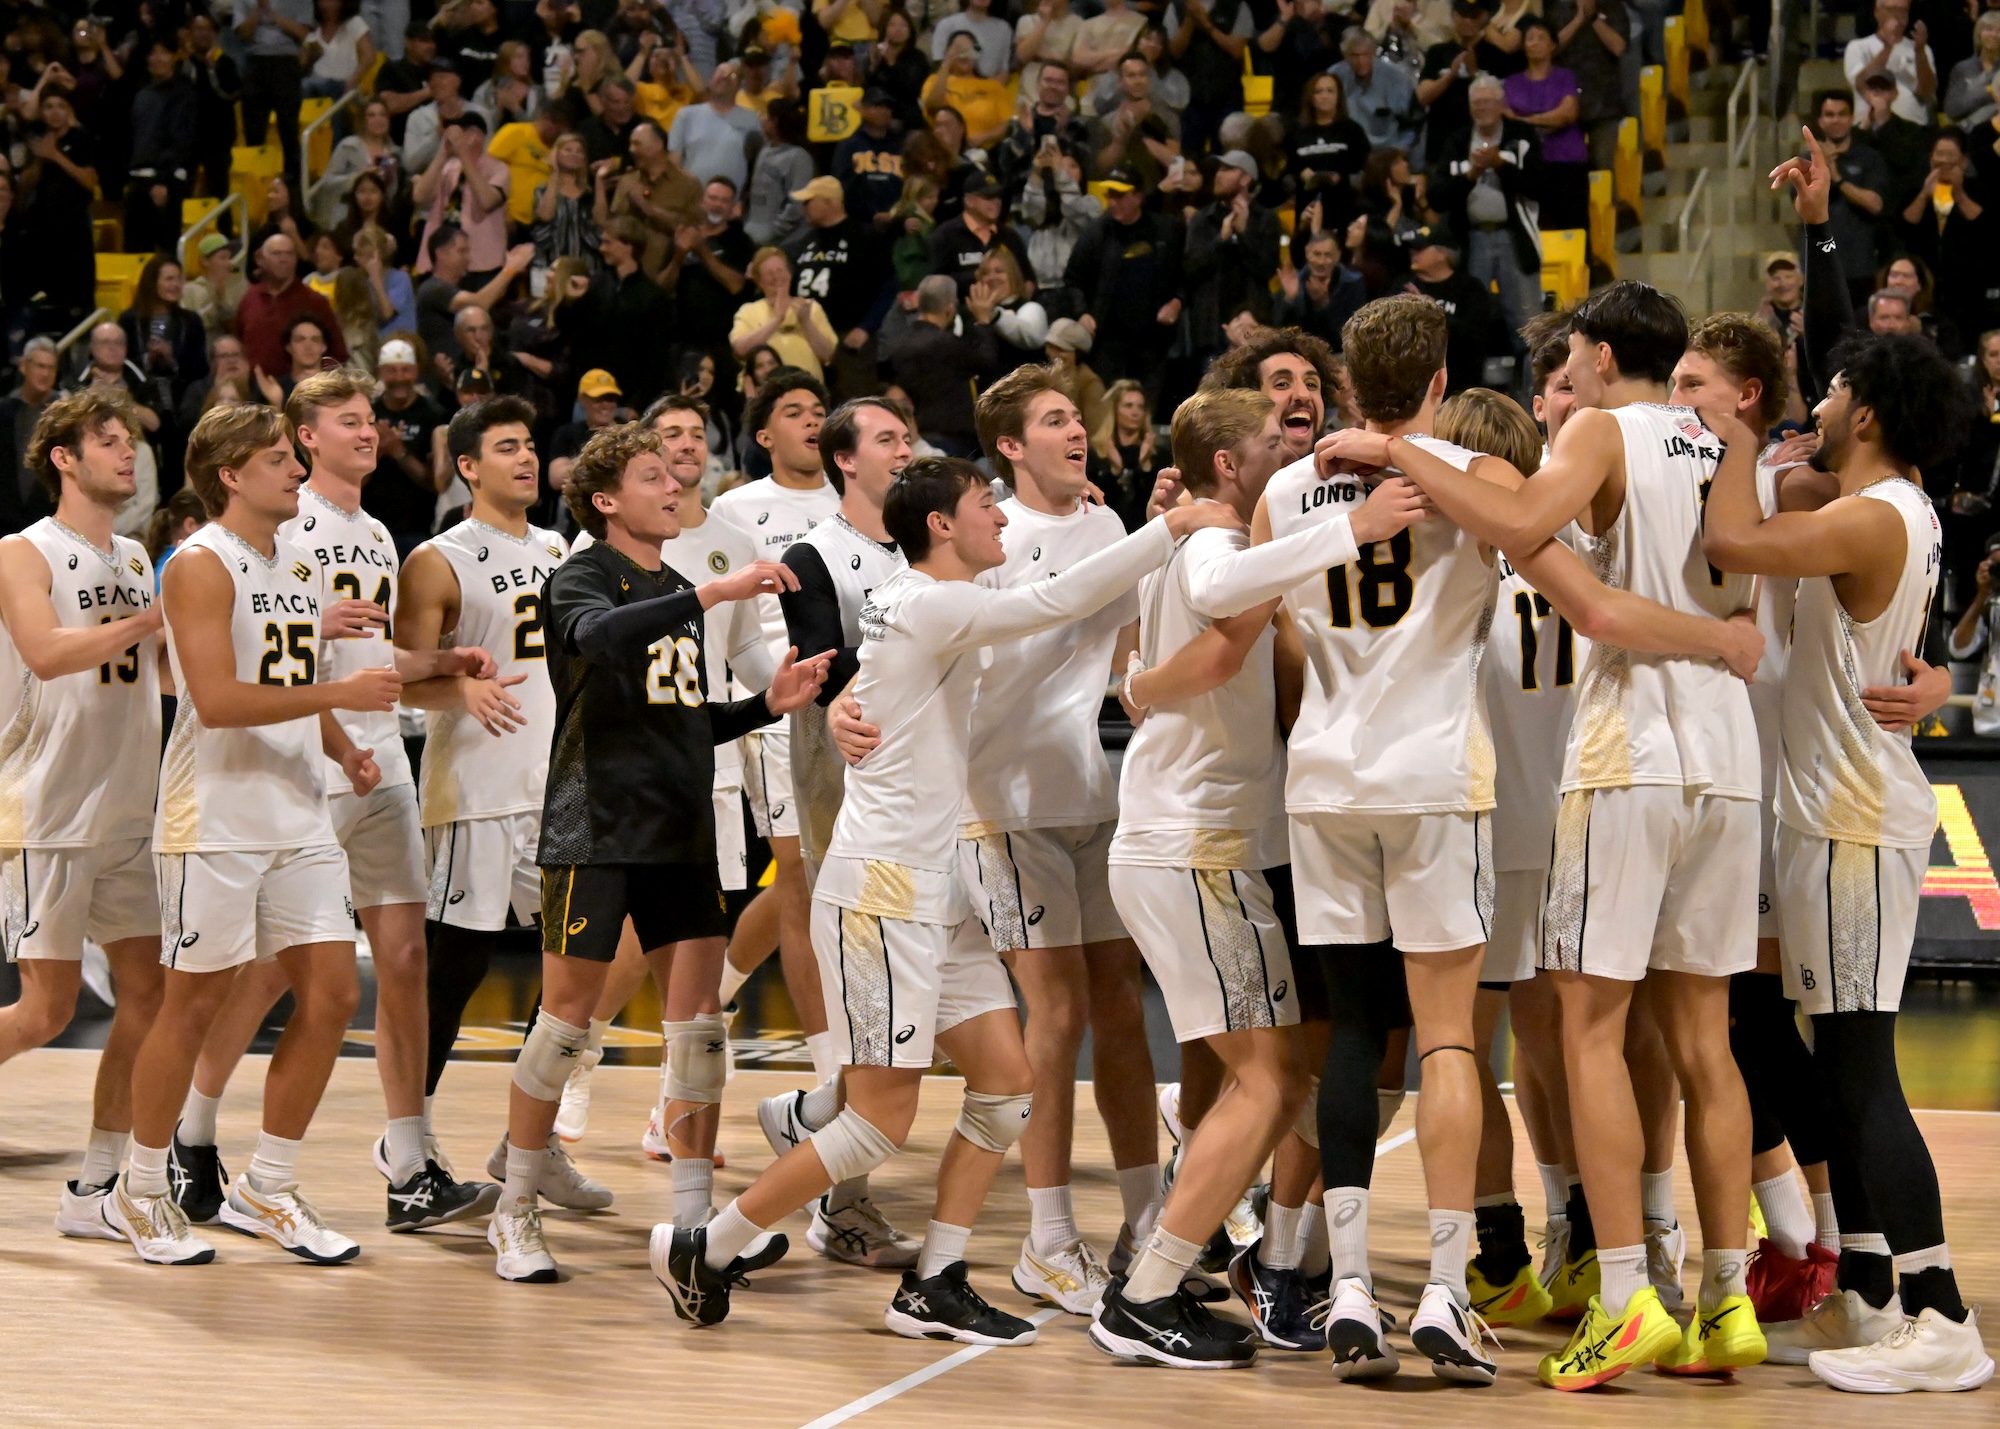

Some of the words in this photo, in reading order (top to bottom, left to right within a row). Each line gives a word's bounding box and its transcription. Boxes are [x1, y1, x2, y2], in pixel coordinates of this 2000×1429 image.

[797, 267, 831, 298] 24
[1302, 483, 1356, 514] LONG
[766, 533, 793, 546] LONG
[313, 545, 395, 574] BEACH
[1325, 526, 1416, 630] 18
[78, 584, 151, 611] BEACH
[252, 593, 319, 618] BEACH
[258, 621, 316, 686] 25
[1513, 589, 1577, 692] 17
[646, 634, 705, 708] 28
[1799, 963, 1817, 991] LB
